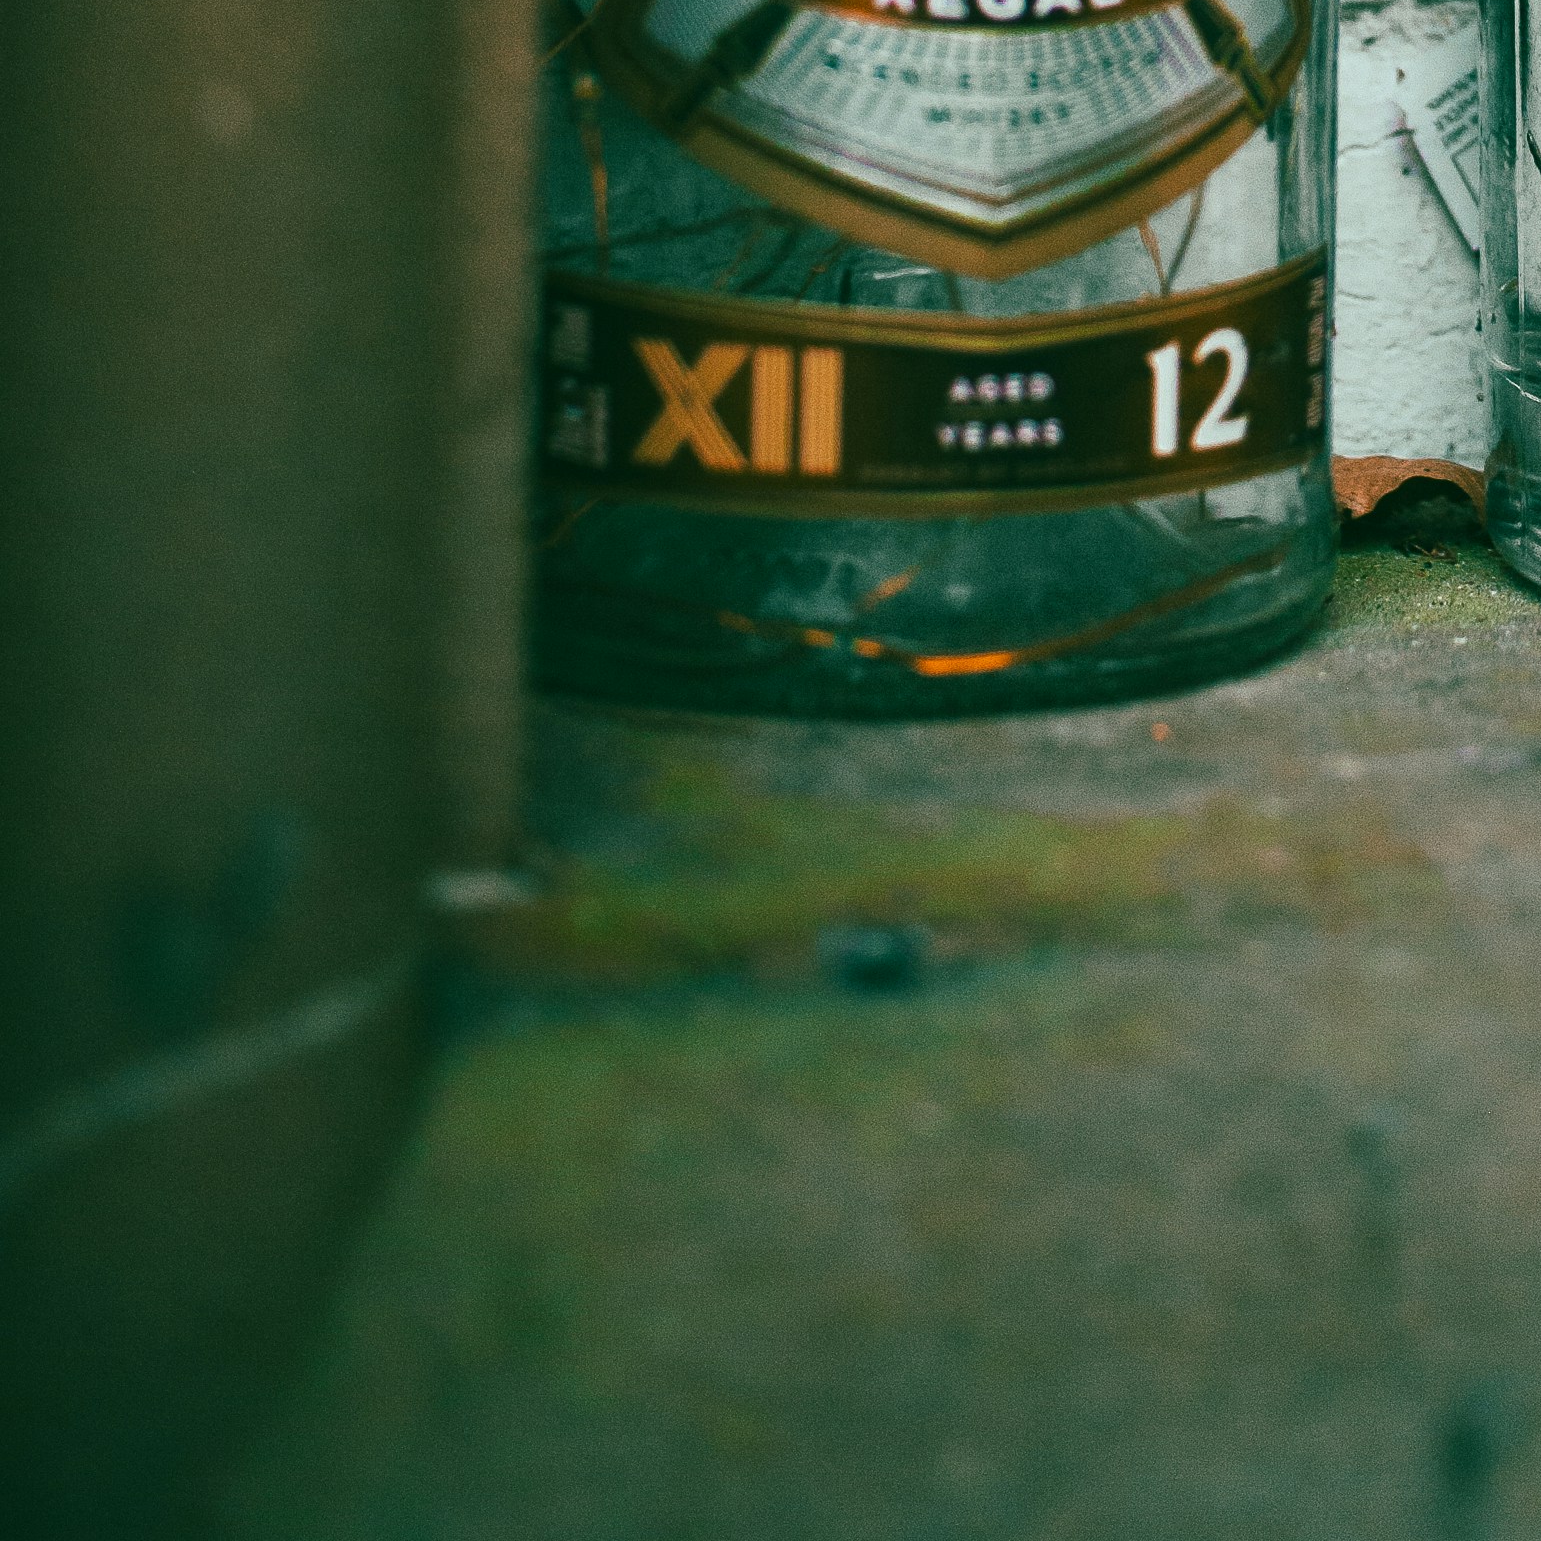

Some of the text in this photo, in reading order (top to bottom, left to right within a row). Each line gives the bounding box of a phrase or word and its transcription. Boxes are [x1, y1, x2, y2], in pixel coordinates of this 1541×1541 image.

[631, 337, 844, 477] XII
[947, 370, 1057, 405] AGED
[1144, 326, 1252, 458] 12
[933, 418, 1066, 453] YEARS
